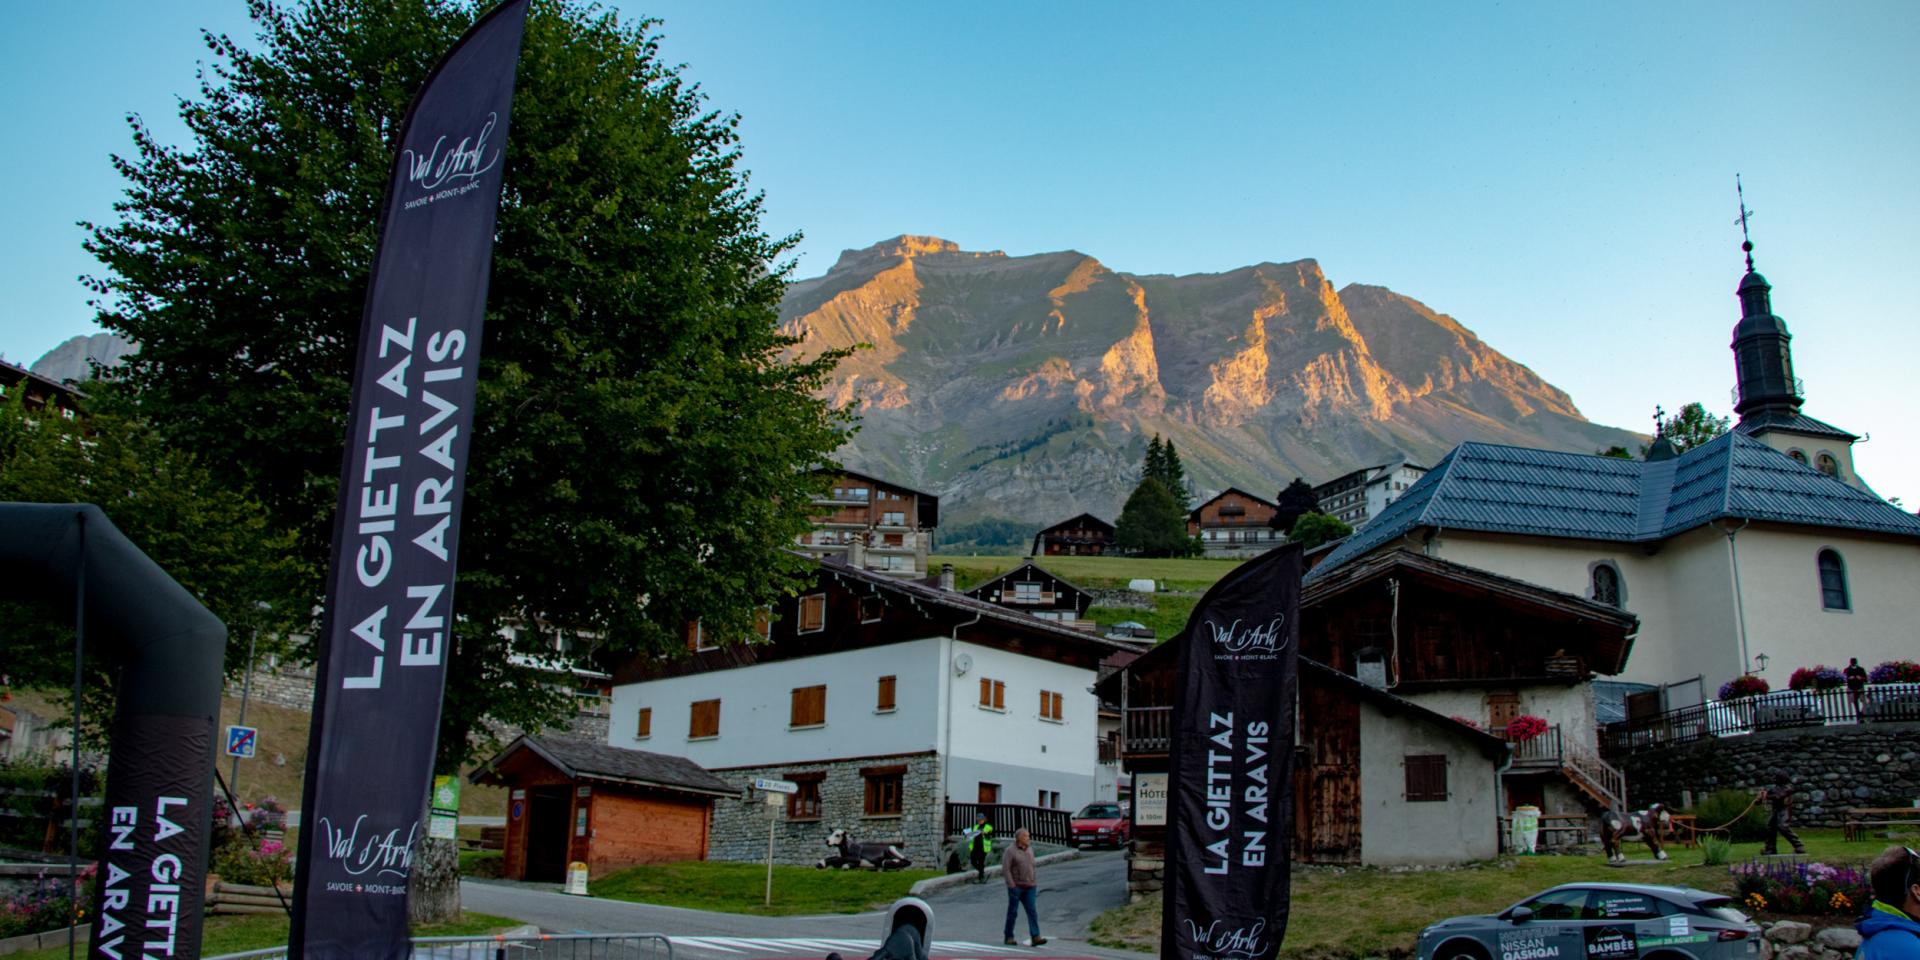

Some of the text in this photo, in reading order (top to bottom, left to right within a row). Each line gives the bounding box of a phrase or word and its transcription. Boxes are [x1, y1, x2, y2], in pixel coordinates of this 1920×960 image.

[403, 135, 447, 182] Val
[404, 196, 429, 210] SAVOIE
[342, 317, 417, 690] LA GIETTAZ
[400, 328, 466, 666] EN ARAVIS
[1203, 617, 1243, 643] Val
[1140, 788, 1168, 799] HÔTE
[1204, 711, 1234, 875] LA GIETTAZ
[1242, 720, 1269, 867] EN ARAVIS
[109, 806, 139, 850] EN
[154, 795, 189, 842] LA
[319, 814, 368, 859] Val
[327, 882, 353, 892] SAVOIE
[1183, 918, 1222, 943] Val
[1500, 937, 1545, 952] NISSAN
[1588, 938, 1635, 954] BAMBÉE
[1502, 945, 1560, 960] QASHQAI
